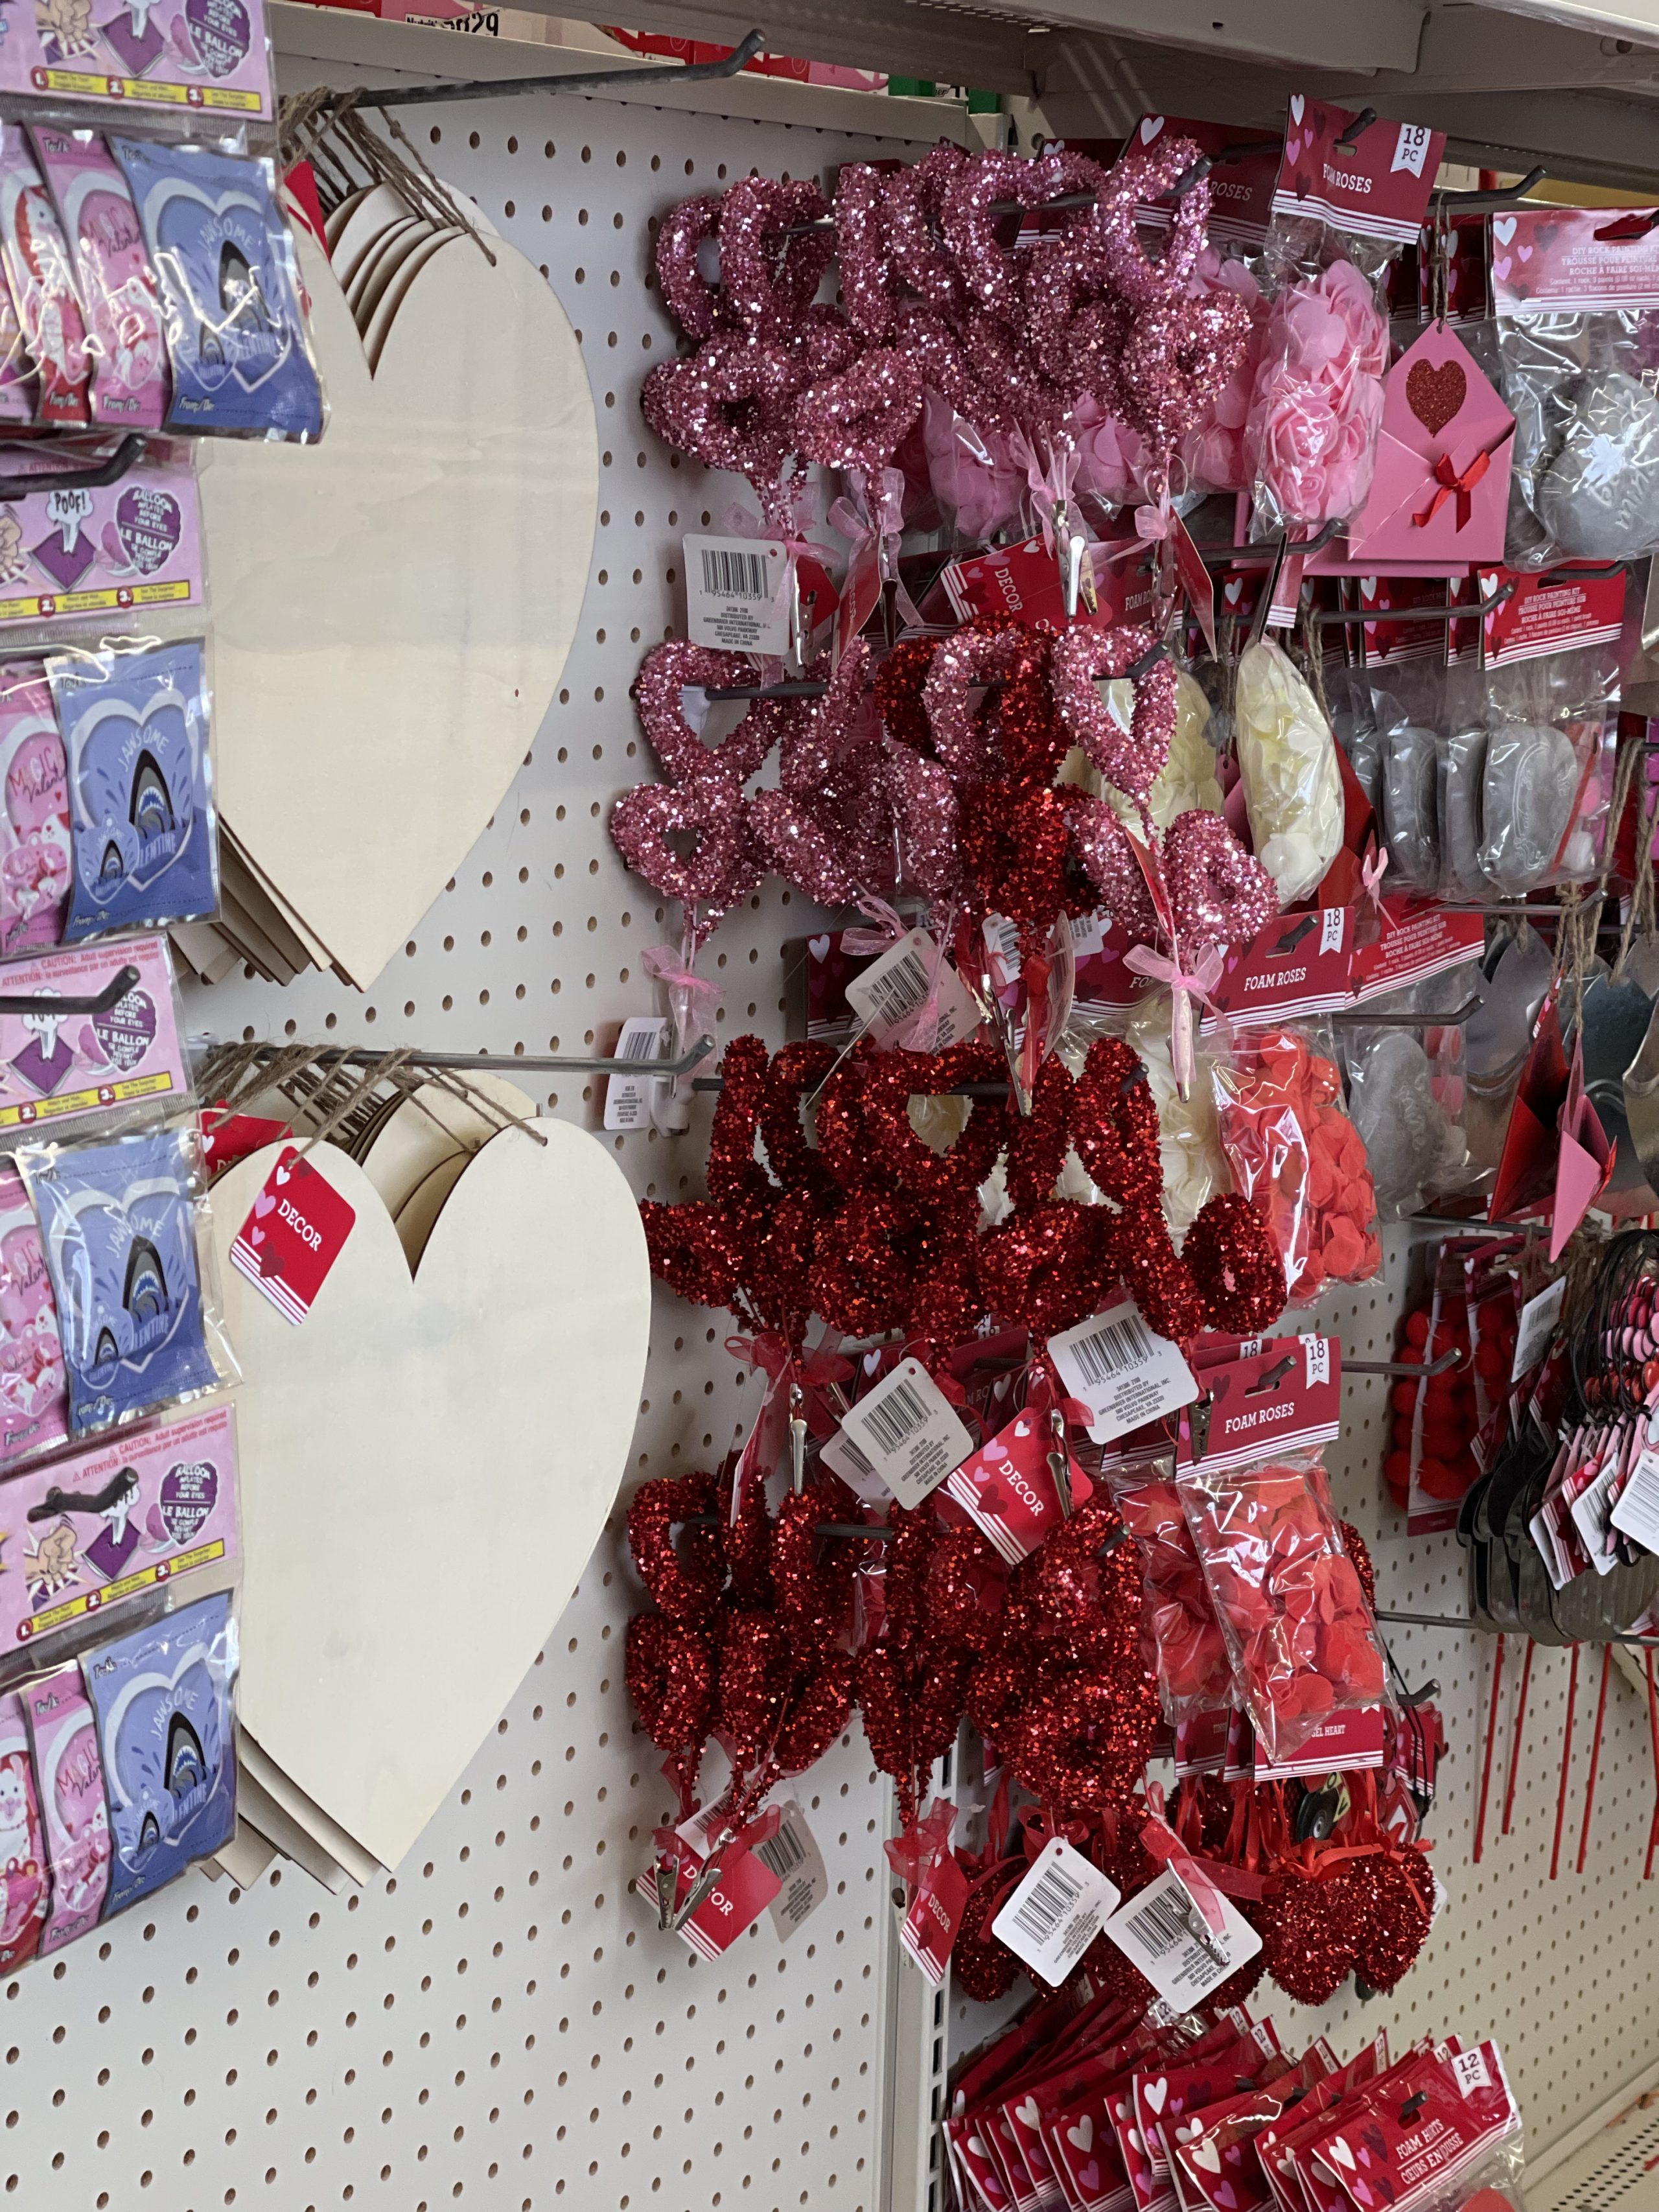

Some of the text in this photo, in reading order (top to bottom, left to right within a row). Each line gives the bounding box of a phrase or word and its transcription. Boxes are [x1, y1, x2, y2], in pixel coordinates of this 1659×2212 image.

[1403, 126, 1426, 148] 18
[1401, 148, 1419, 163] PC
[1209, 180, 1253, 202] ROSES
[1336, 173, 1373, 195] ROSES
[1560, 257, 1597, 266] TROUSSE
[1569, 266, 1597, 275] ROCHE
[1607, 265, 1628, 274] FAIRE
[54, 491, 86, 515] POOF!
[121, 527, 173, 551] LE BALLON
[994, 568, 1025, 613] DECOR
[1125, 596, 1143, 612] FOAM
[118, 725, 170, 772] JAWSOME
[1326, 909, 1341, 927] 18
[1326, 929, 1339, 942] PC
[41, 954, 76, 970] CAUTION:
[1244, 966, 1307, 992] FOAM ROSES
[97, 1027, 149, 1047] LE BALLON
[277, 1198, 322, 1252] DECOR
[1243, 1340, 1258, 1359] 18
[1309, 1340, 1325, 1360] 18
[1095, 1369, 1121, 1386] 95464
[1123, 1355, 1148, 1372] 10359
[1311, 1362, 1324, 1375] PC
[1122, 1390, 1159, 1412] VOLVO PARKWAY
[1126, 1414, 1141, 1425] MADE
[1145, 1404, 1161, 1415] CHINA
[1224, 1401, 1295, 1434] FOAM ROSES
[119, 1436, 152, 1454] CAUTION:
[174, 1464, 211, 1480] BALLOON
[999, 1460, 1045, 1517] DECOR
[163, 1505, 210, 1519] LE BALLON
[150, 1688, 200, 1740] JAWSOME
[1325, 1724, 1346, 1736] HEART
[927, 1892, 951, 1935] DECOR
[1043, 1918, 1063, 1941] 95464
[1062, 1892, 1080, 1916] 10359
[1160, 1936, 1183, 1957] 95464
[1254, 2027, 1267, 2044] 12
[1435, 2047, 1450, 2064] 12
[1457, 2053, 1481, 2073] 12
[1465, 2070, 1482, 2085] PC
[1395, 2134, 1423, 2160] FOAM
[1426, 2149, 1444, 2168] EN
